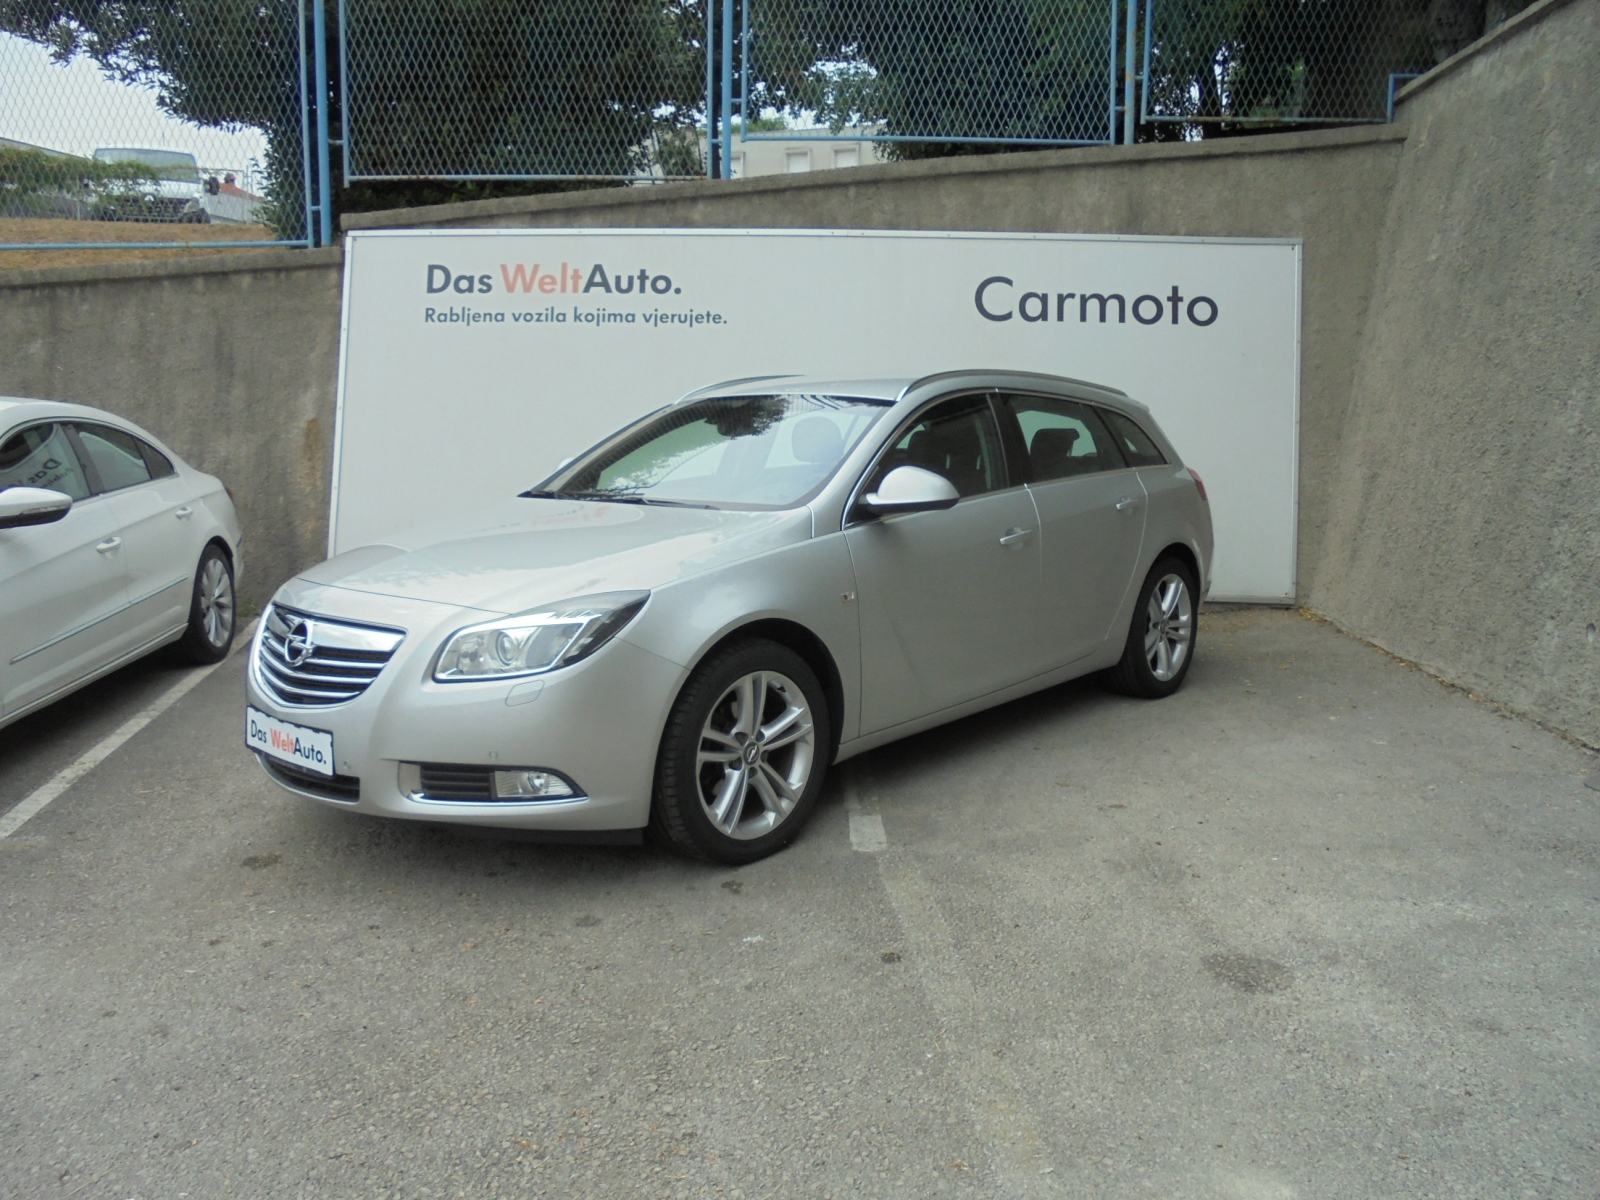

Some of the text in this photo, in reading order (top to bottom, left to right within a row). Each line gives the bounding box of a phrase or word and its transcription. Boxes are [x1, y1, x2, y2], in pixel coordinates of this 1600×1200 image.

[426, 262, 682, 295] Das WeltAuto.
[974, 275, 1219, 327] Carmoto
[424, 306, 728, 328] Rabljena vozila kojima vjerujete.
[250, 719, 267, 744] Das
